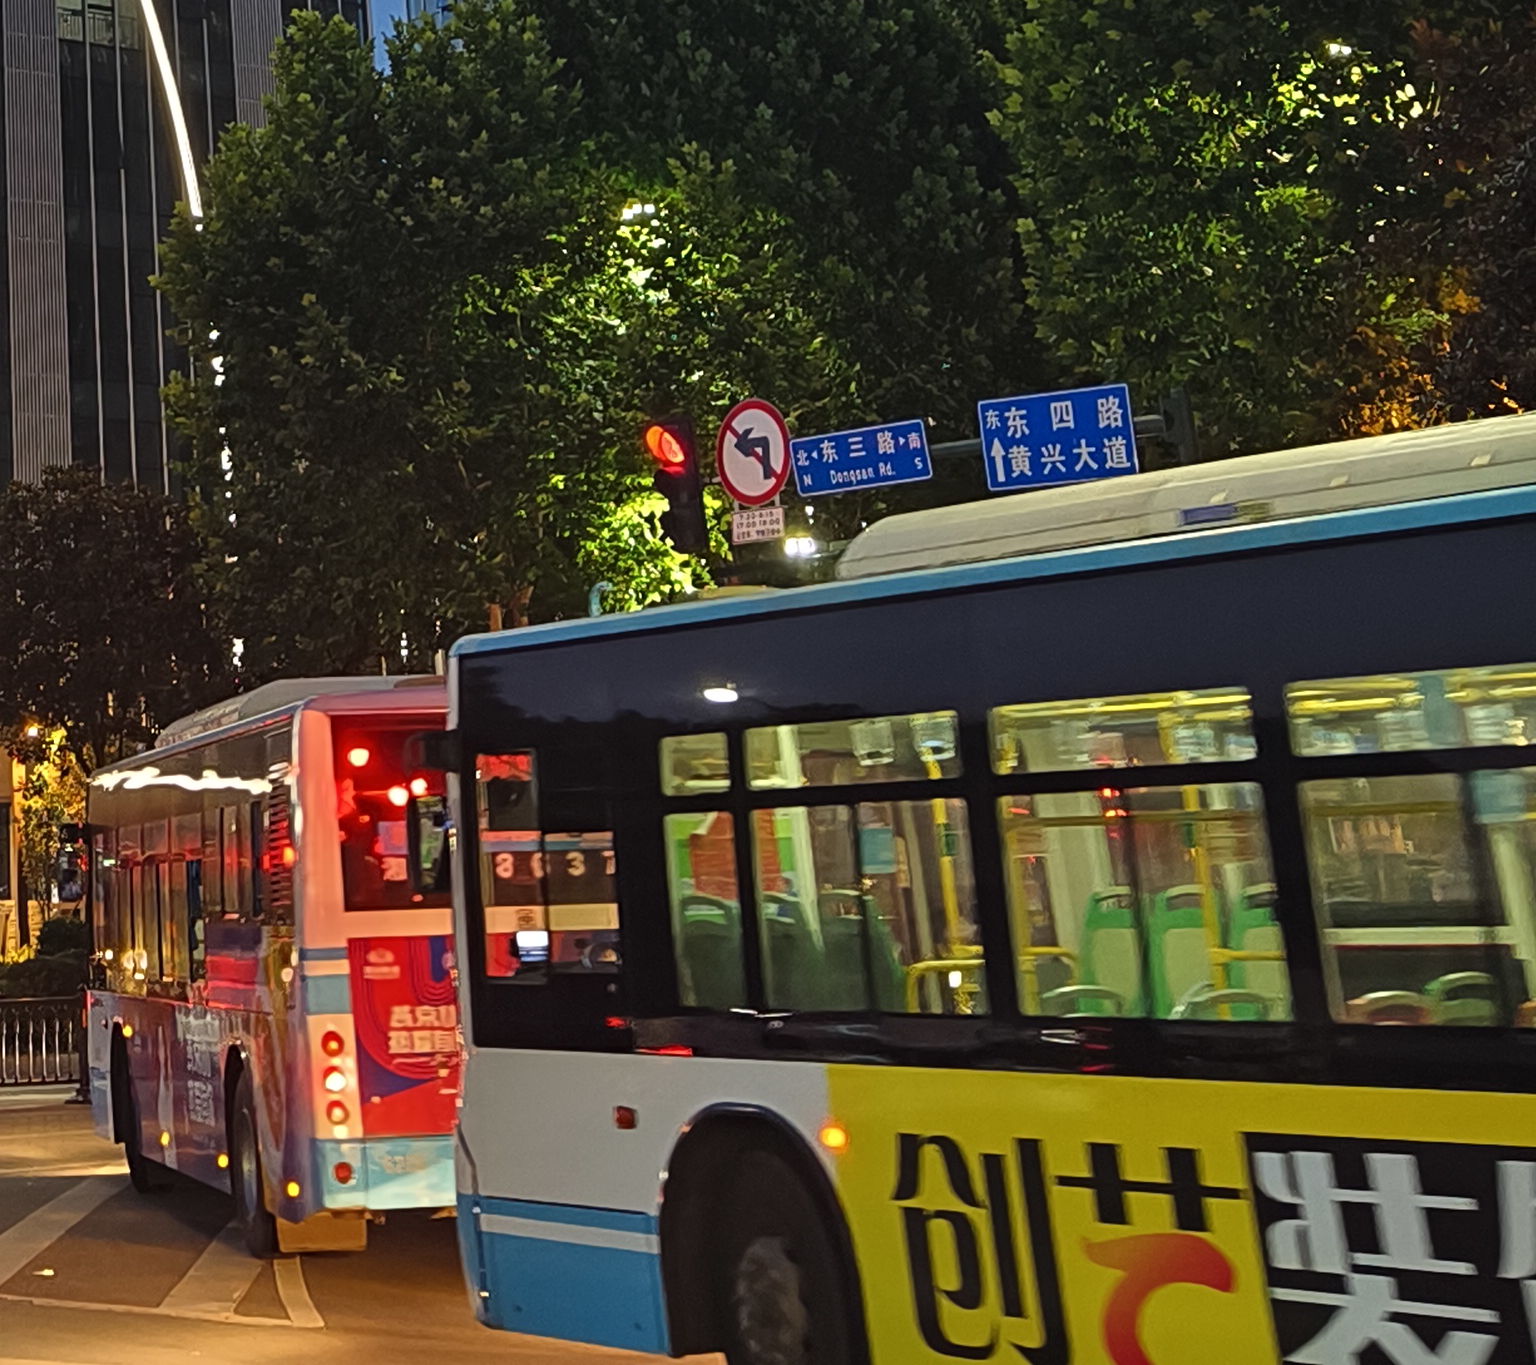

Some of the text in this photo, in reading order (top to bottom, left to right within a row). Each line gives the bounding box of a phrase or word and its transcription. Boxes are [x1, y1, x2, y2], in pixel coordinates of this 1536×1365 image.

[985, 395, 1124, 438] 东 东四路
[797, 430, 921, 466] 北 东三路 南
[1008, 435, 1131, 478] 黄兴大道
[803, 473, 812, 486] N
[830, 467, 875, 485] Dongsan
[914, 457, 923, 469] S
